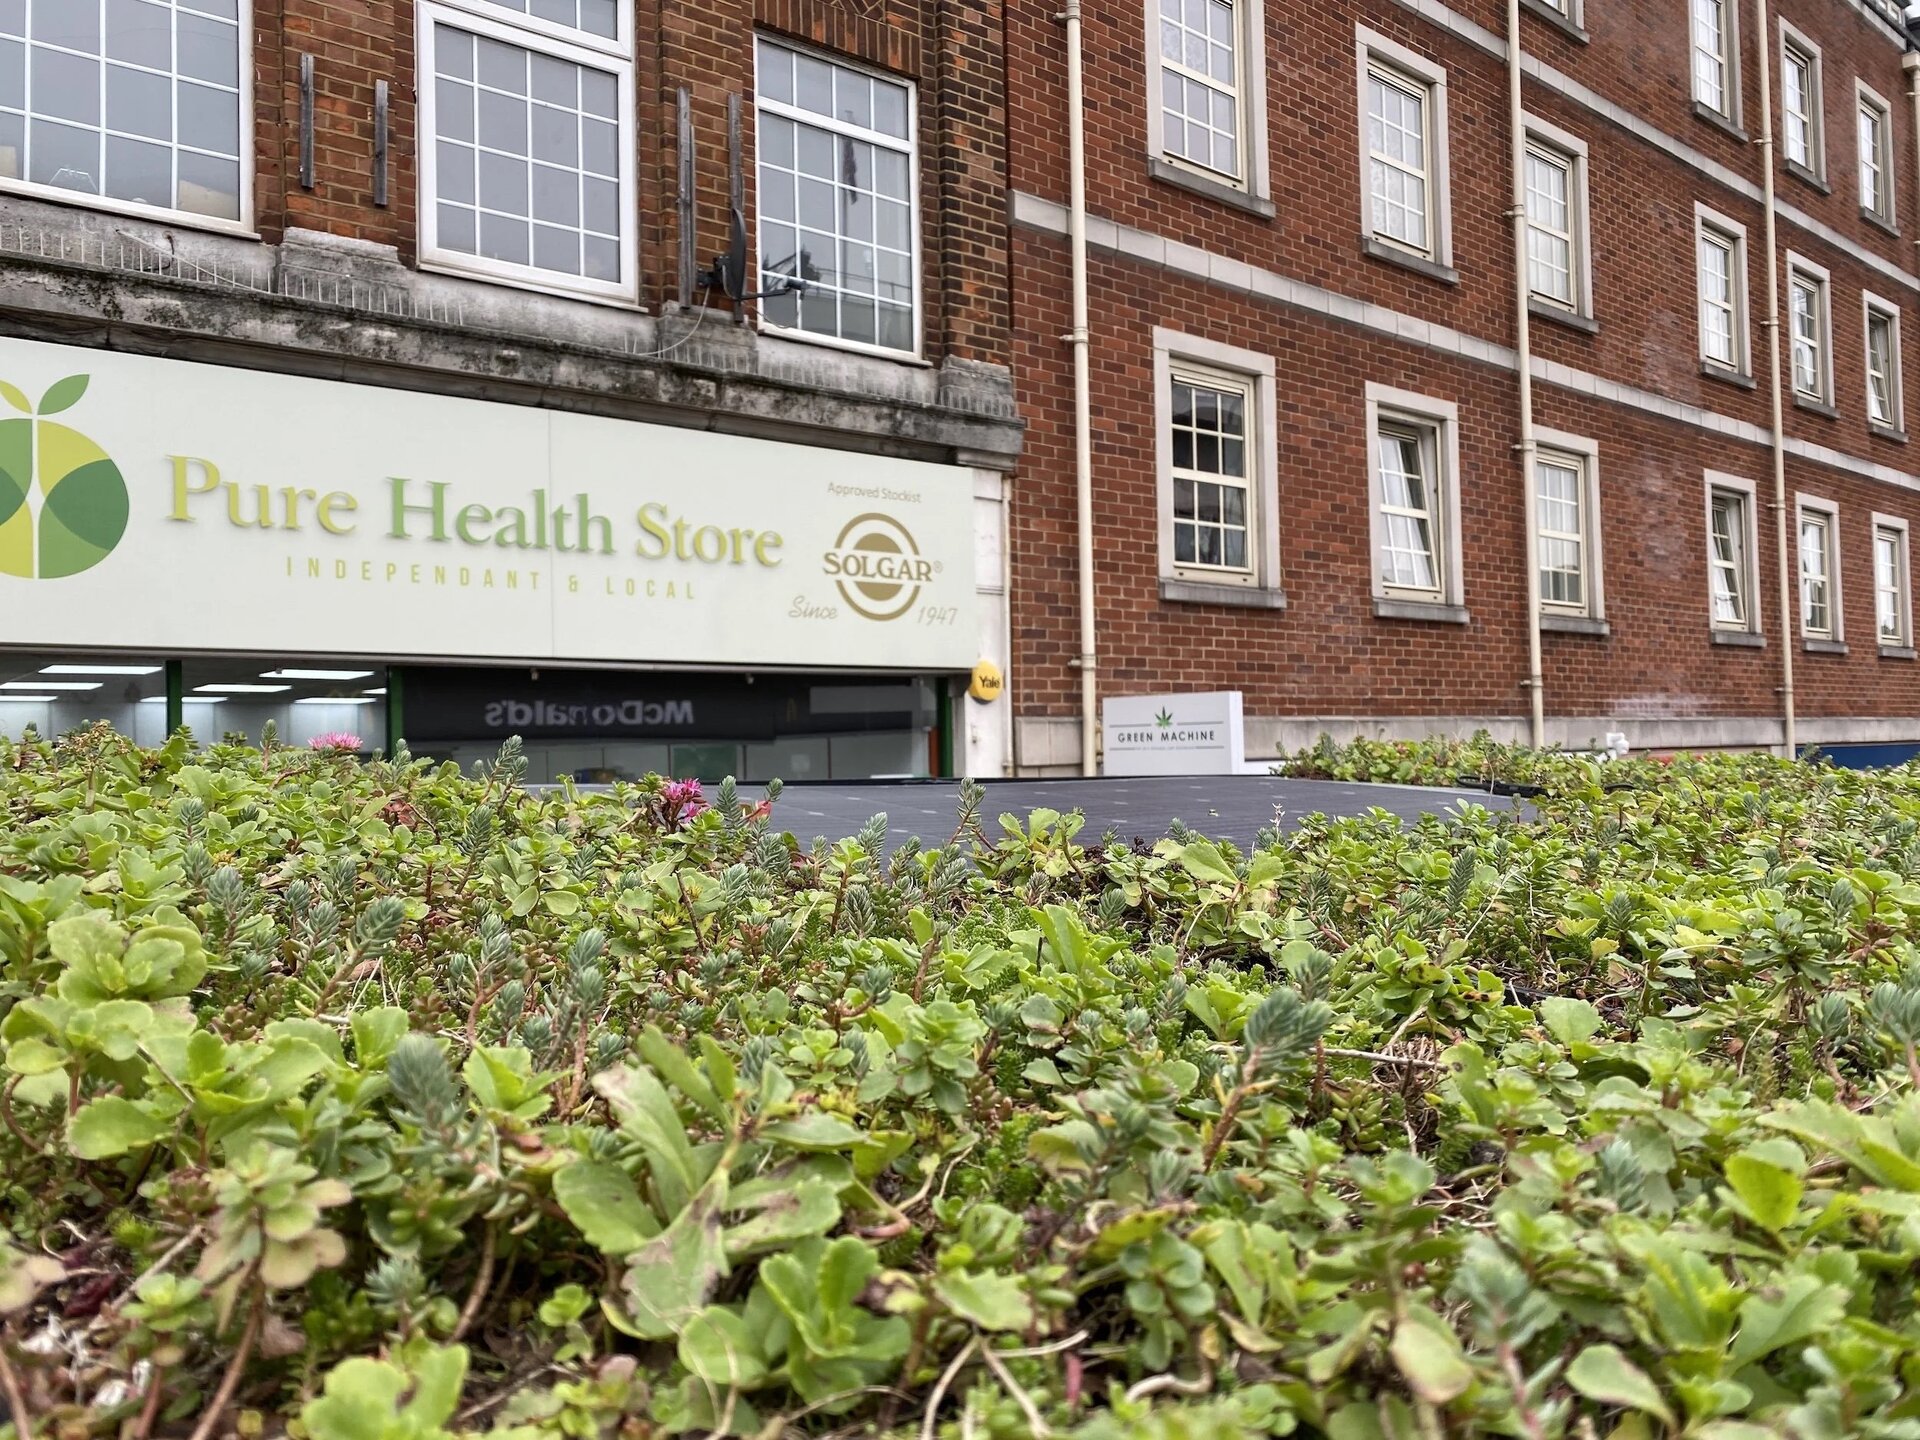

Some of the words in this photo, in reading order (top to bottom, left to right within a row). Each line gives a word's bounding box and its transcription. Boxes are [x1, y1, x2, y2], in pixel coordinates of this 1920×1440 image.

[828, 481, 880, 499] Approved
[164, 454, 358, 535] Pure
[386, 476, 616, 555] Health
[635, 502, 784, 567] Store
[286, 556, 540, 590] INDEPENDANT
[568, 574, 578, 593] &
[606, 576, 695, 600] LOCAL
[788, 595, 838, 620] Since
[917, 606, 958, 626] 1947
[979, 675, 1000, 688] Yale
[1118, 732, 1153, 743] GREEN
[1160, 730, 1215, 741] MACHINE
